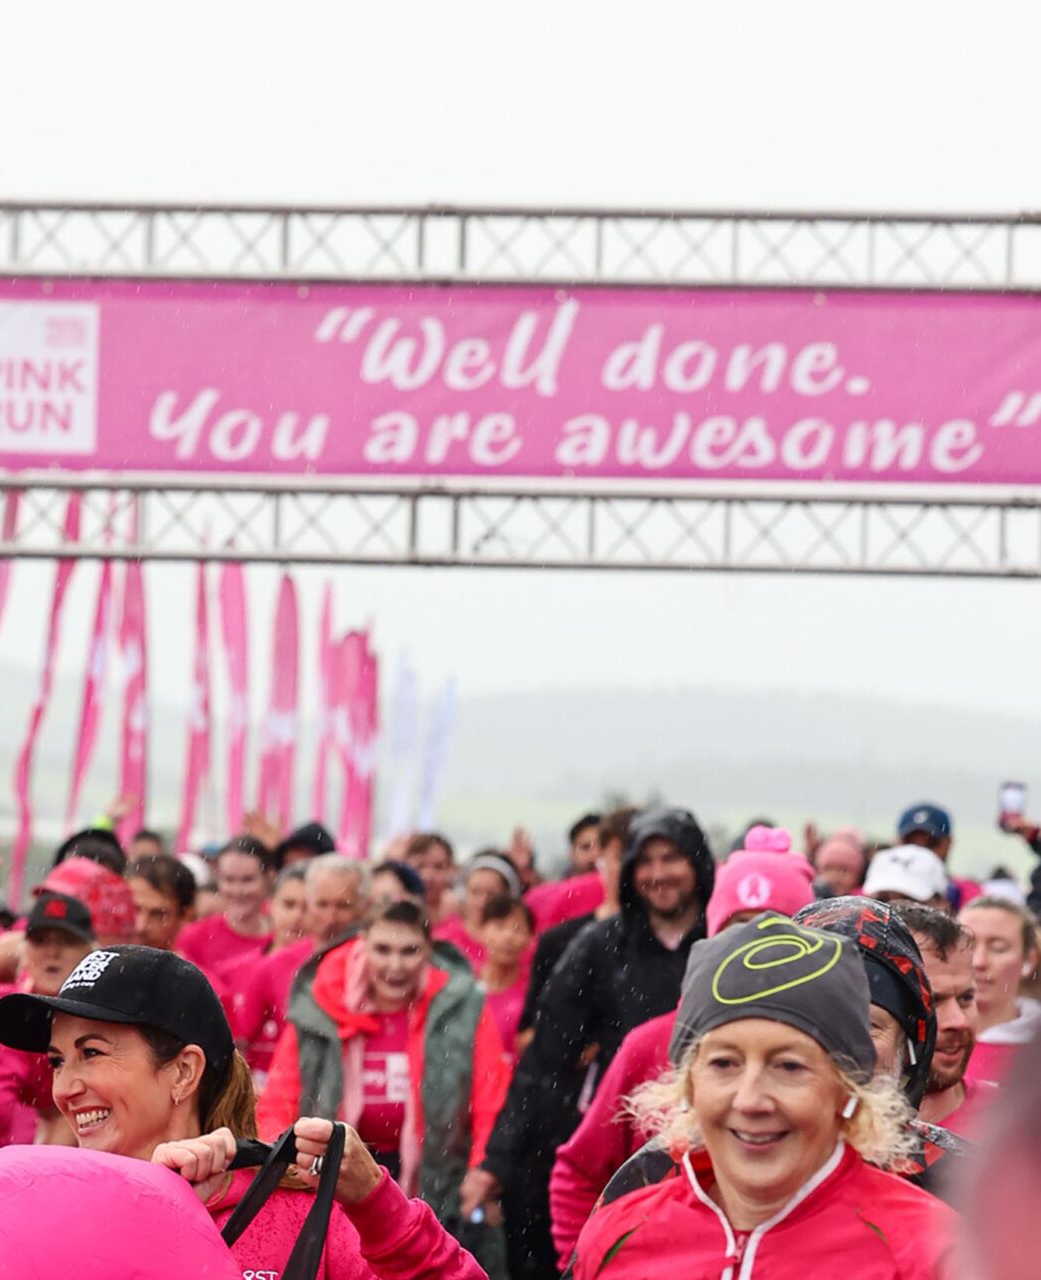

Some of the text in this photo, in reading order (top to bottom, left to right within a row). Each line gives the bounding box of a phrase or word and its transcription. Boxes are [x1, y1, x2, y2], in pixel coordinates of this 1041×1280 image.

[601, 323, 871, 397] done.
[149, 388, 331, 461] You
[363, 409, 523, 467] are
